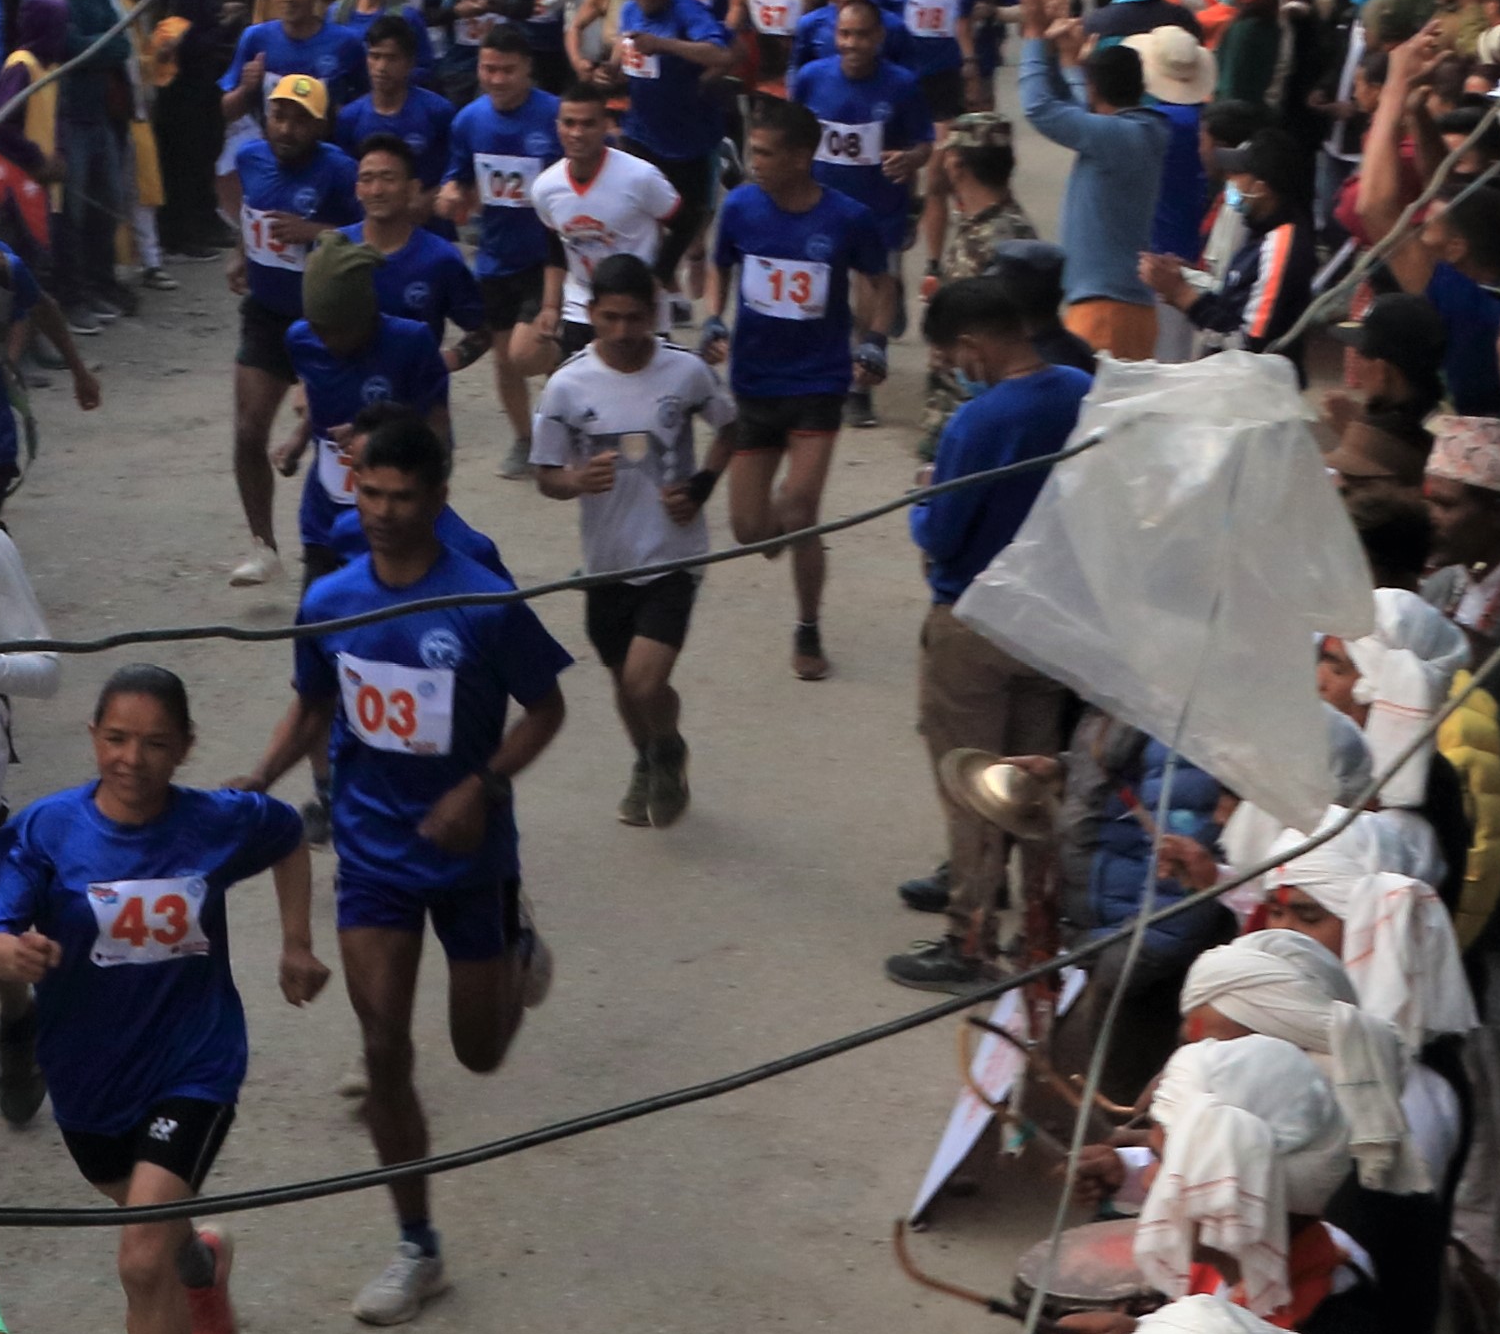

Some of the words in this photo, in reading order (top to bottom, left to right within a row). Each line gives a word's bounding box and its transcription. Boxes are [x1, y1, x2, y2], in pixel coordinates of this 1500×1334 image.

[768, 269, 812, 304] 13
[356, 684, 417, 738] 03
[110, 894, 189, 947] 43
